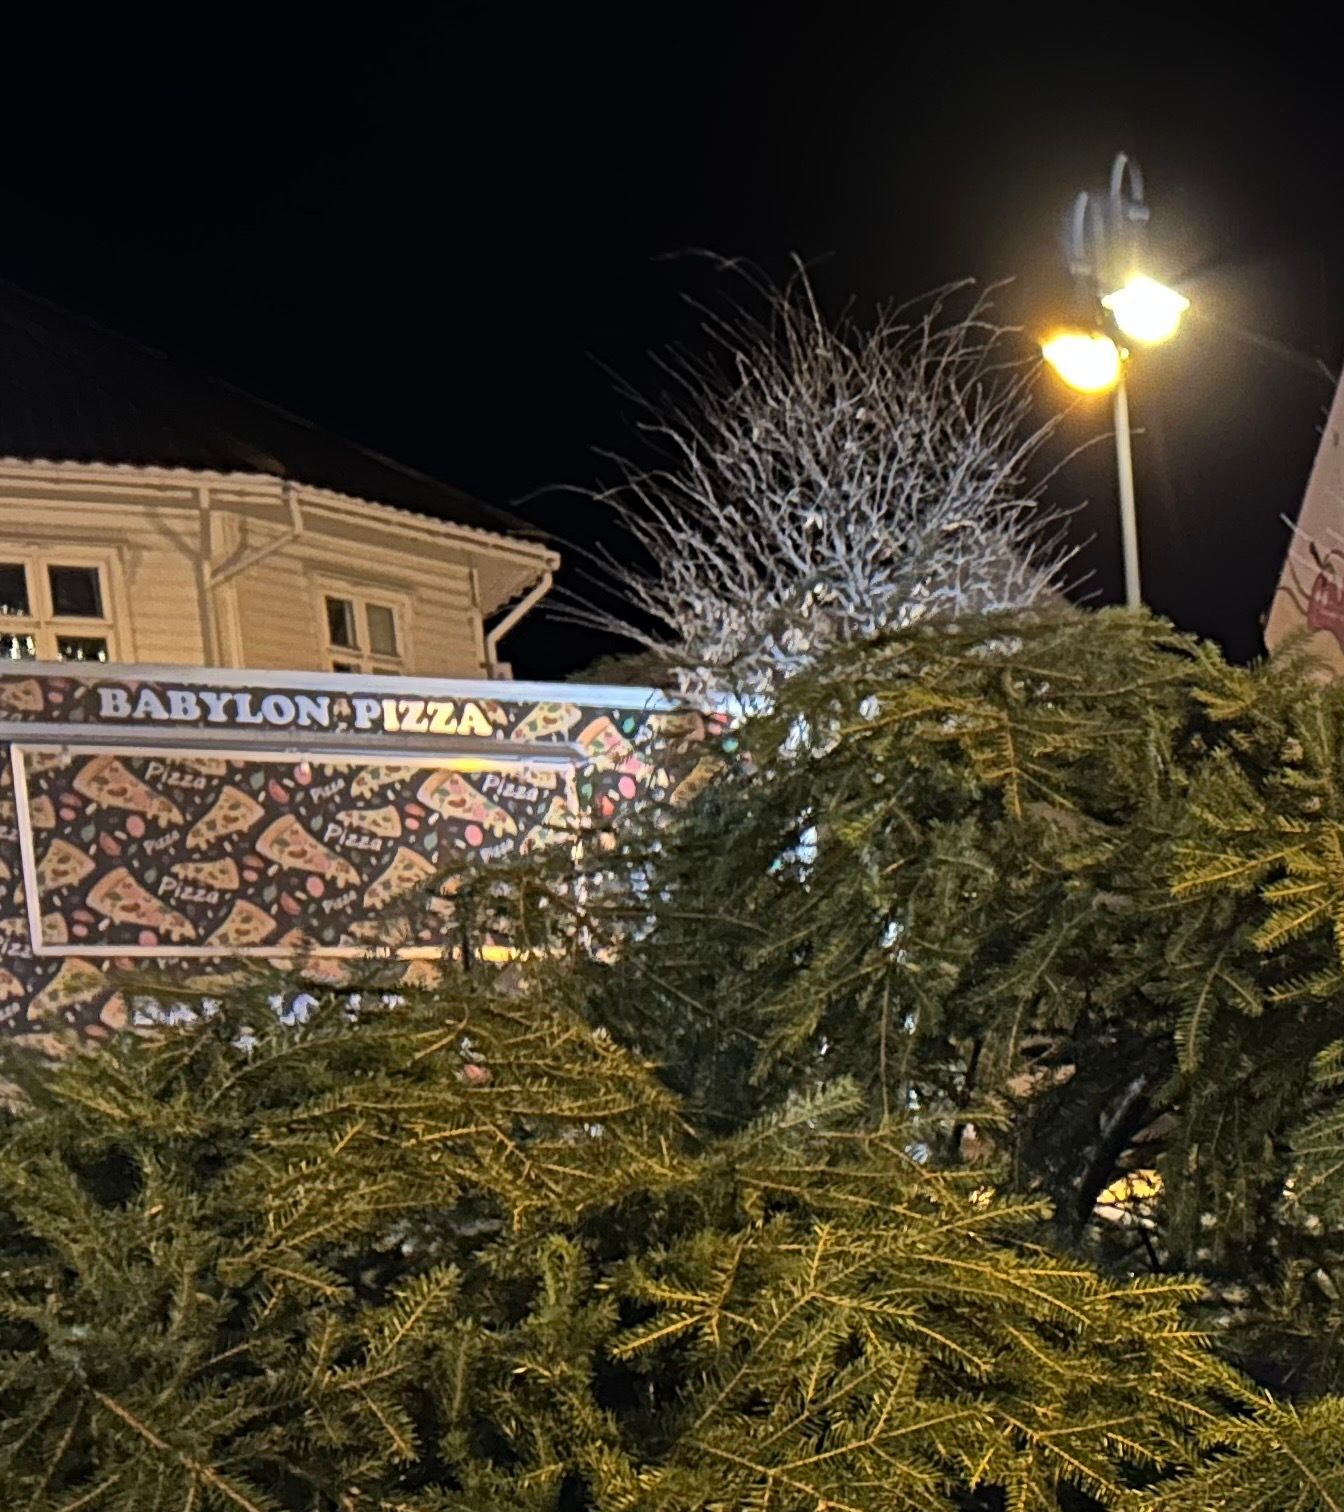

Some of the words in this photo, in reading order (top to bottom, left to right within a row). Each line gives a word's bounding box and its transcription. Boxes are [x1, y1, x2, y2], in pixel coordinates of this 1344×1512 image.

[97, 687, 330, 726] BABYLON
[352, 698, 493, 736] PIZZA
[145, 761, 207, 790] Pizza
[481, 773, 539, 801] Pizza
[323, 822, 383, 851] Pizza
[158, 875, 220, 904] Pizza
